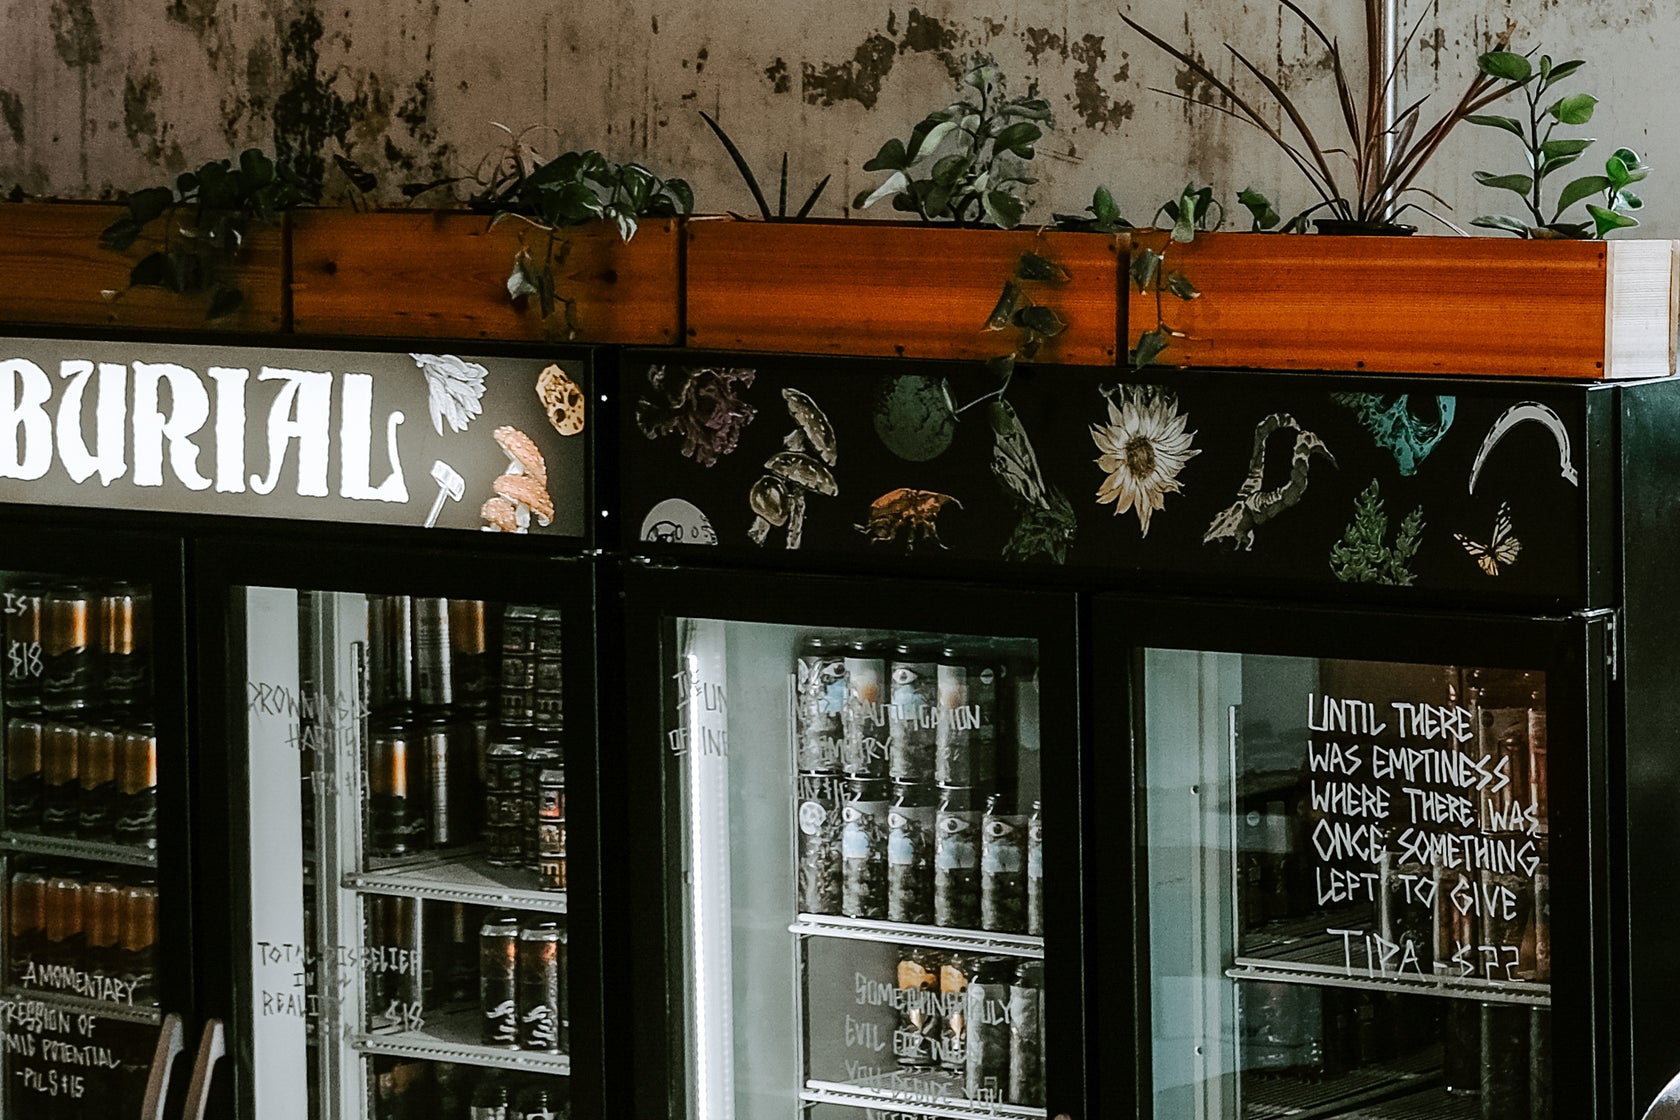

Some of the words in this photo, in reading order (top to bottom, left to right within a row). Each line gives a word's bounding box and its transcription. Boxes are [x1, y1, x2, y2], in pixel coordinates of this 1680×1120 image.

[0, 357, 410, 504] BURIAL
[8, 640, 43, 680] $18
[1307, 692, 1386, 737] UNTIL
[1391, 701, 1474, 743] THERE
[1307, 739, 1362, 776] WAS
[1372, 744, 1511, 794] EMPTINESS
[1310, 779, 1391, 820] WHERE
[1402, 786, 1476, 829] THERE
[1488, 797, 1541, 839] WAS
[1311, 818, 1387, 864] ONCE
[1396, 827, 1541, 878] SOMETHING
[1315, 865, 1380, 908] LEFT
[1397, 873, 1438, 910] TO
[1450, 876, 1518, 922] GIVE
[1325, 927, 1428, 983] TIPA
[39, 964, 140, 1007] MOMENTARY
[77, 1013, 97, 1039] OF
[385, 998, 425, 1033] $18
[844, 1014, 886, 1053] EVIL
[42, 1038, 121, 1070] POTENTIAL
